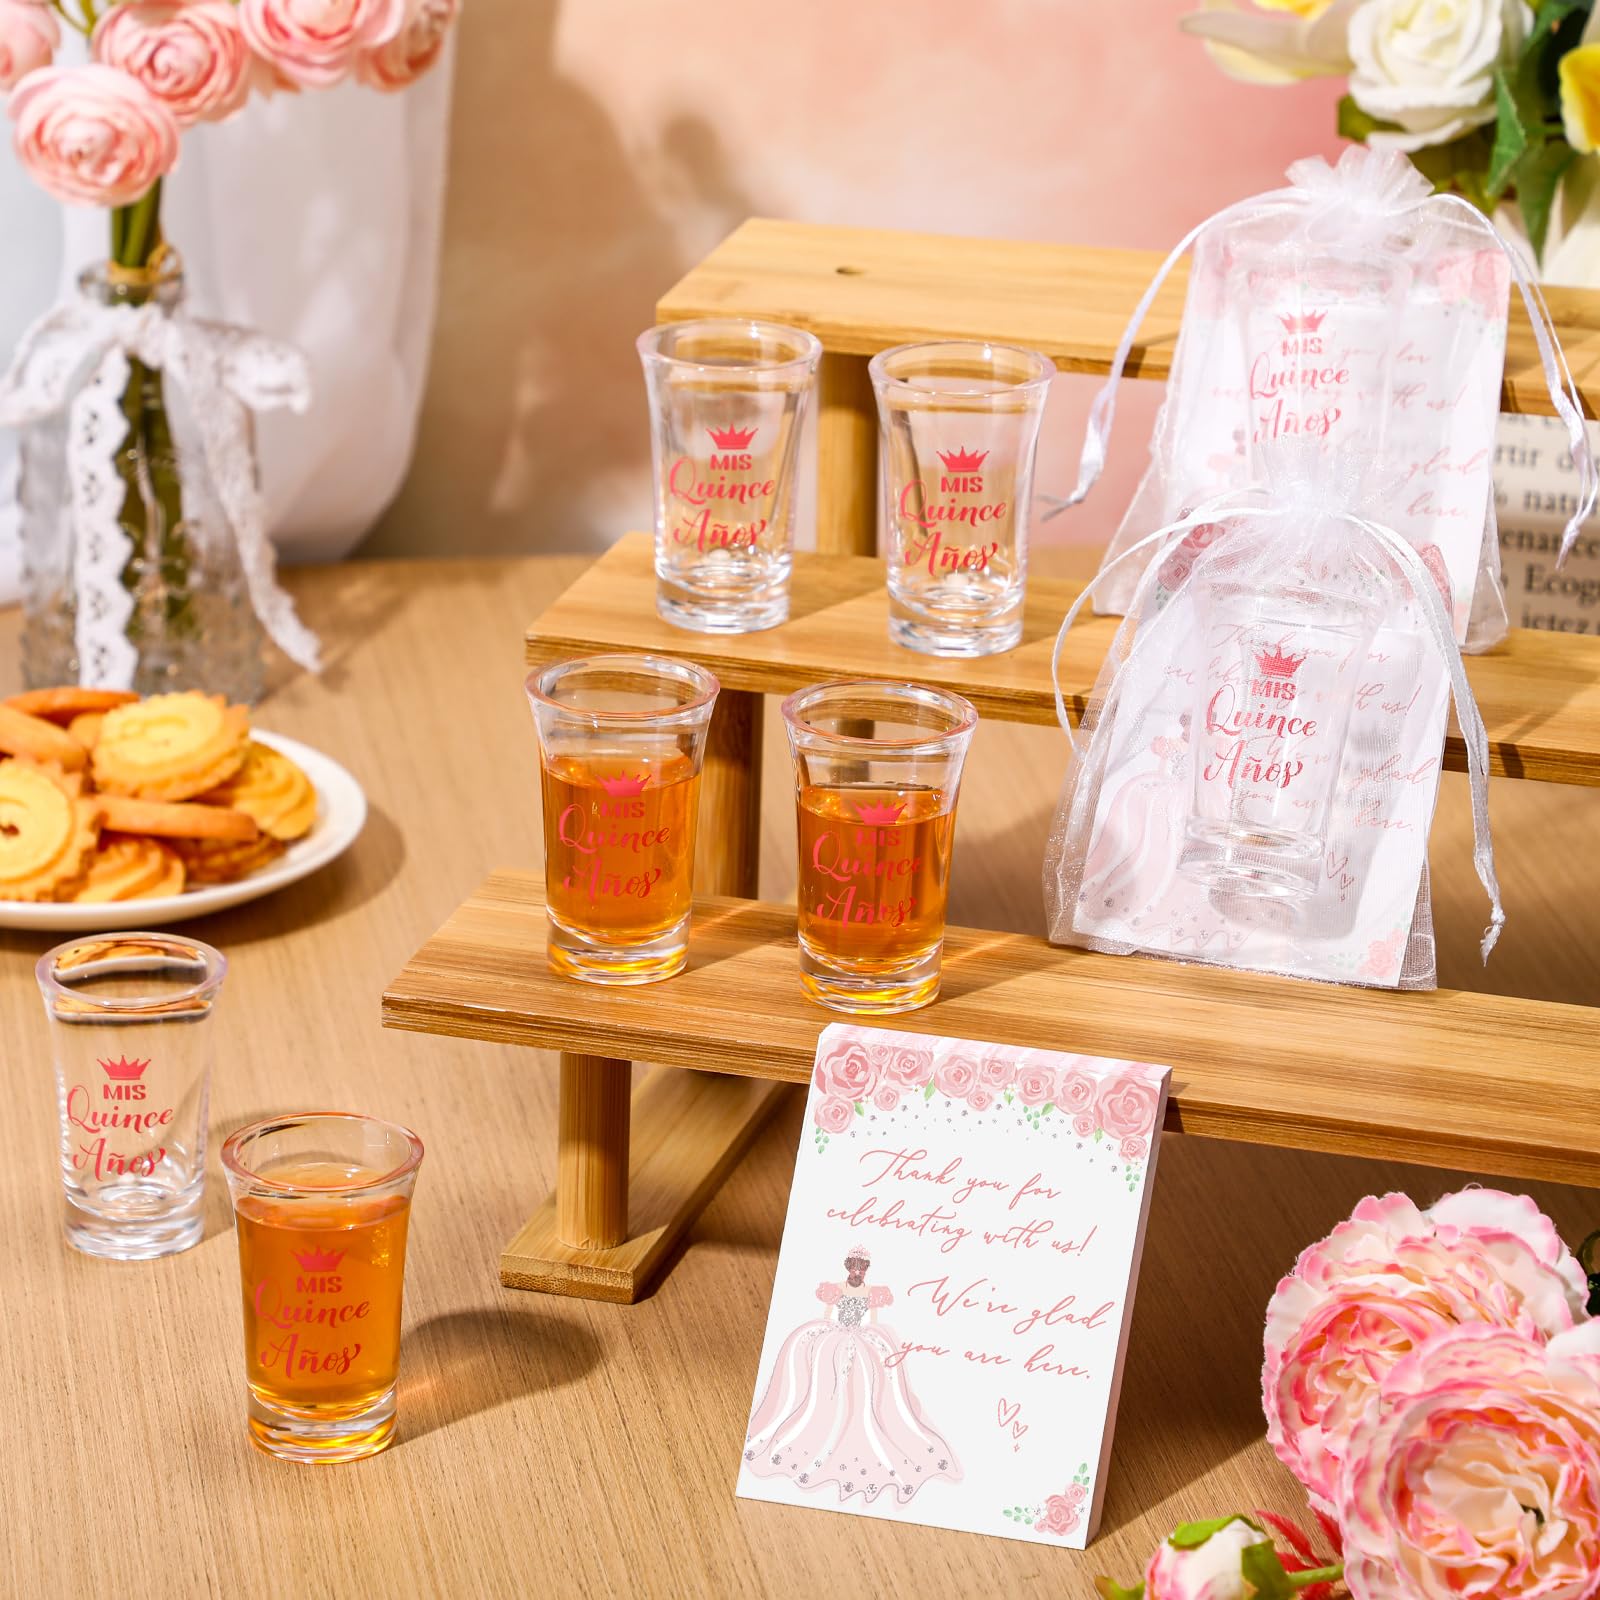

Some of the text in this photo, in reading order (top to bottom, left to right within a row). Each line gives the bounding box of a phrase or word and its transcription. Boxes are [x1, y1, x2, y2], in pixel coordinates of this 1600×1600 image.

[1281, 337, 1323, 356] MIS
[1249, 351, 1350, 400] Quince
[1253, 398, 1342, 444] Años
[669, 456, 776, 505] Quince
[709, 454, 753, 471] MIS
[940, 476, 984, 494] MIS
[900, 480, 1007, 528] Quince
[673, 508, 768, 553] Años
[904, 531, 999, 576] Años
[1205, 683, 1317, 738] Quince
[1250, 678, 1297, 701] MIS
[1203, 739, 1304, 789] Años
[558, 803, 670, 854] Quince
[600, 801, 646, 819] MIS
[811, 830, 922, 881] Quince
[855, 829, 901, 847] MIS
[563, 857, 661, 902] Años
[816, 886, 917, 929] Años
[66, 1085, 174, 1134] Quince
[103, 1084, 147, 1101] MIS
[72, 1138, 166, 1182] Años
[859, 1148, 1062, 1210] Thank you for
[827, 1196, 1098, 1257] celebrating with us!
[254, 1277, 370, 1329] Quince
[295, 1276, 343, 1293] MIS
[907, 1276, 1115, 1335] We're glad
[260, 1333, 362, 1378] Años
[884, 1339, 1091, 1379] you are here.
